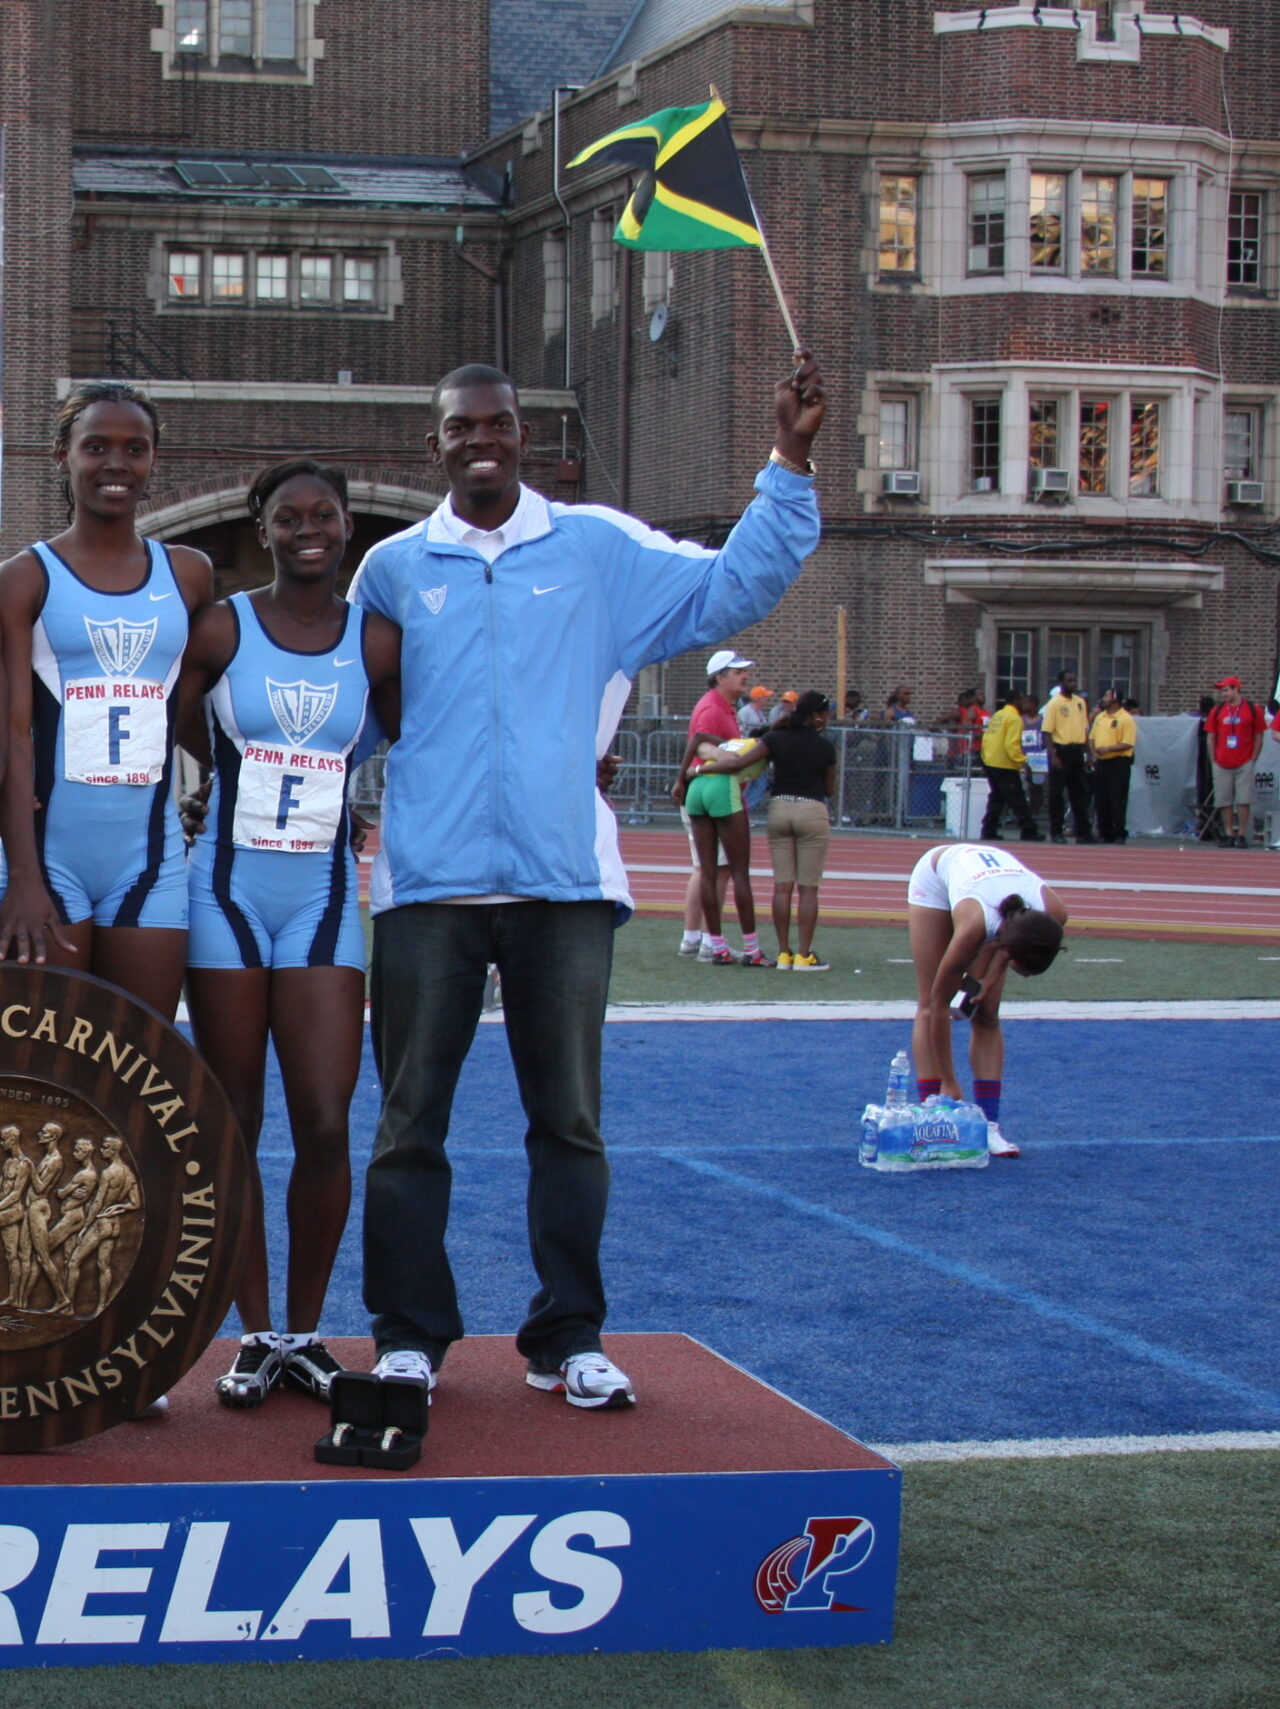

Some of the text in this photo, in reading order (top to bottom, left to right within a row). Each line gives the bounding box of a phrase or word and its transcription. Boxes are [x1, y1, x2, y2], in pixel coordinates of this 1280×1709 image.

[66, 684, 164, 701] PENN RELAYS
[108, 706, 130, 765] F
[244, 747, 344, 773] PENN RELAYS
[85, 774, 119, 784] since
[275, 774, 305, 830] F
[251, 837, 282, 848] since
[1, 1004, 200, 1154] CARNIVAL
[41, 1094, 70, 1108] 1895
